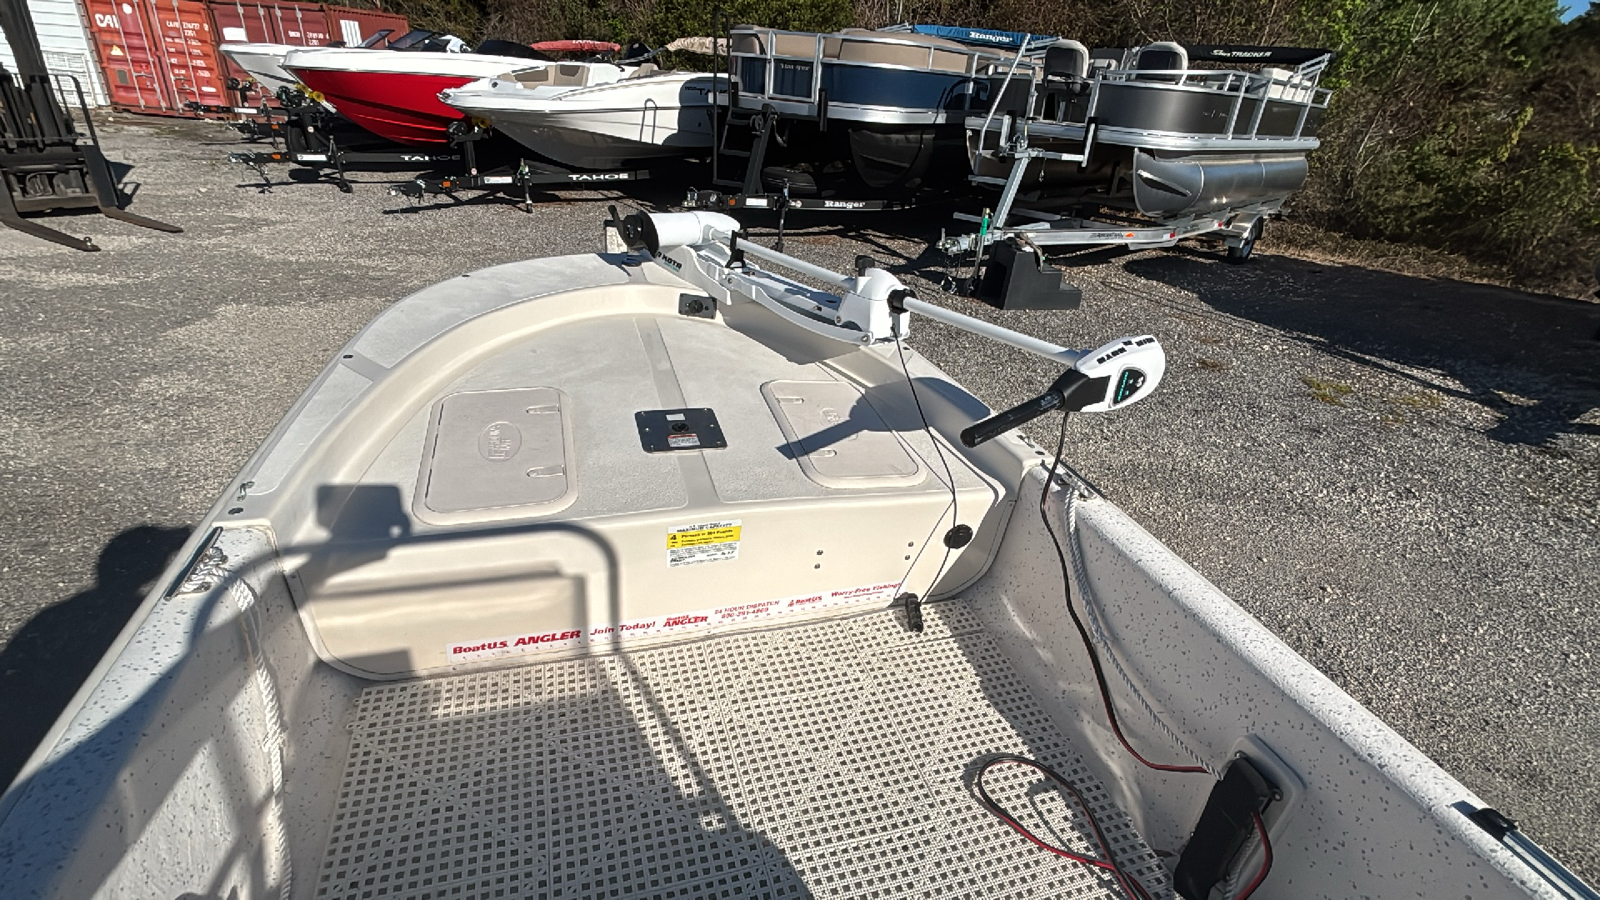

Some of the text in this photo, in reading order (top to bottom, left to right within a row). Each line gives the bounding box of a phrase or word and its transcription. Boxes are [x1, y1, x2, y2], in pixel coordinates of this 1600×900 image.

[969, 32, 1013, 43] Ranger
[567, 172, 629, 181] TAHOE
[824, 200, 866, 209] Ranger
[746, 600, 780, 610] DISPATCH
[662, 616, 709, 628] ANGLER
[590, 621, 656, 636] Join Today!
[513, 630, 582, 647] ANGLER
